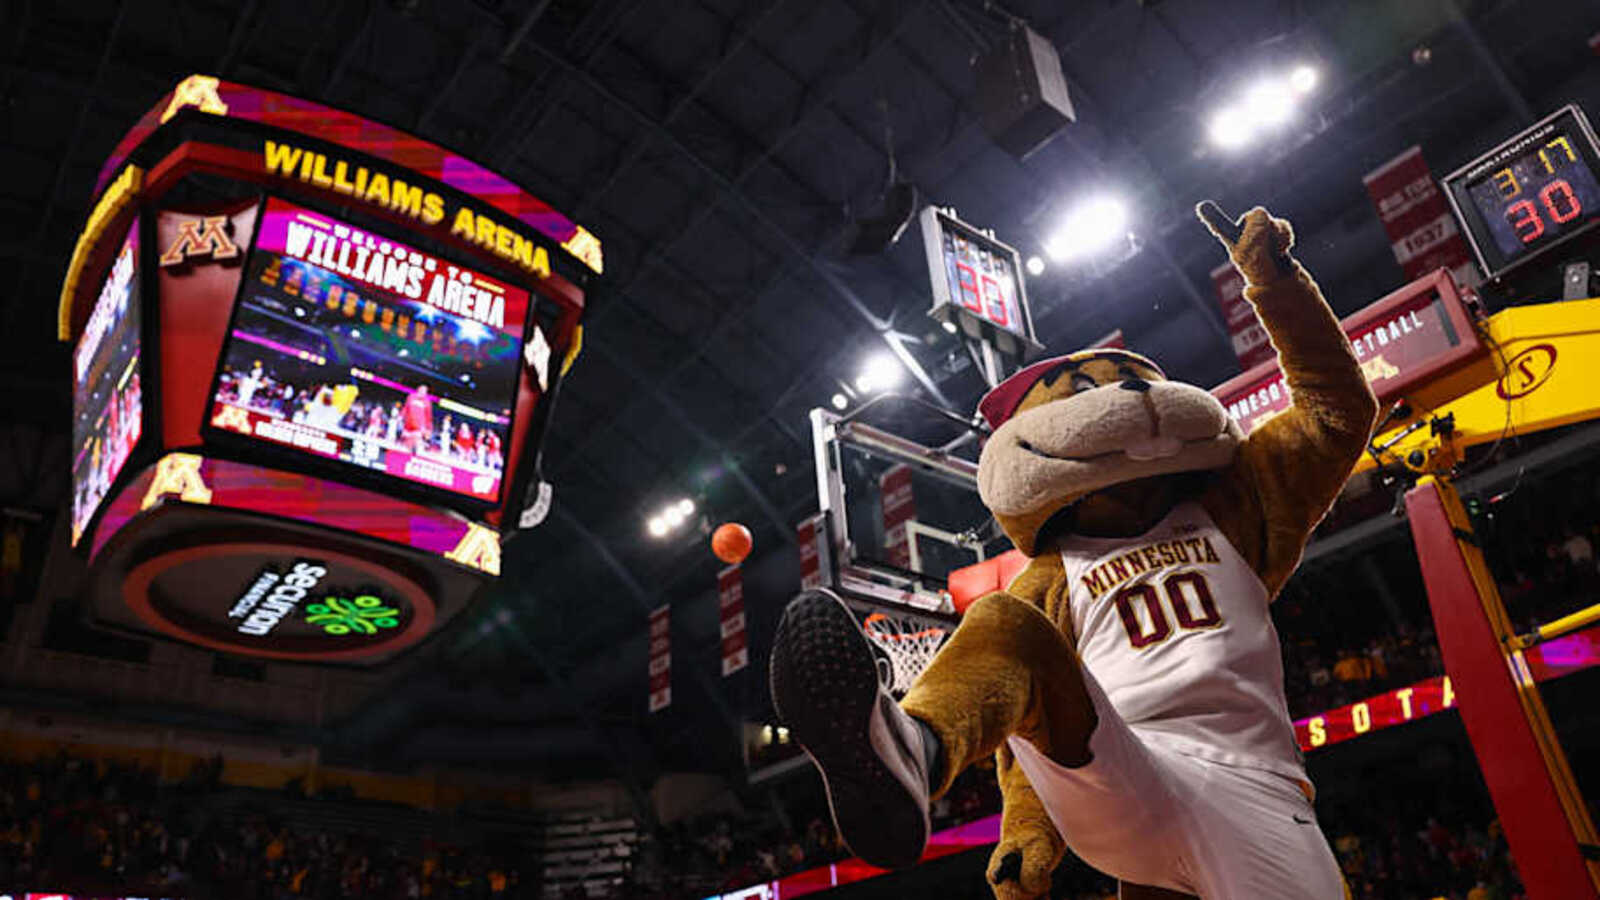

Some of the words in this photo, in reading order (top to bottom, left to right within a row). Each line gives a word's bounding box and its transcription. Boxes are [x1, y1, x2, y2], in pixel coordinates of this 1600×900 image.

[160, 215, 238, 266] M
[264, 140, 446, 226] WILLIAMS
[451, 207, 551, 277] ARENA
[1506, 179, 1582, 243] 30
[286, 221, 426, 299] WILLIAMS
[428, 274, 505, 329] ARENA
[334, 224, 437, 272] WELCOME
[448, 266, 473, 285] TO
[1353, 310, 1424, 357] ETBALL
[1081, 535, 1221, 600] MINNESOTA
[1113, 568, 1224, 649] 00
